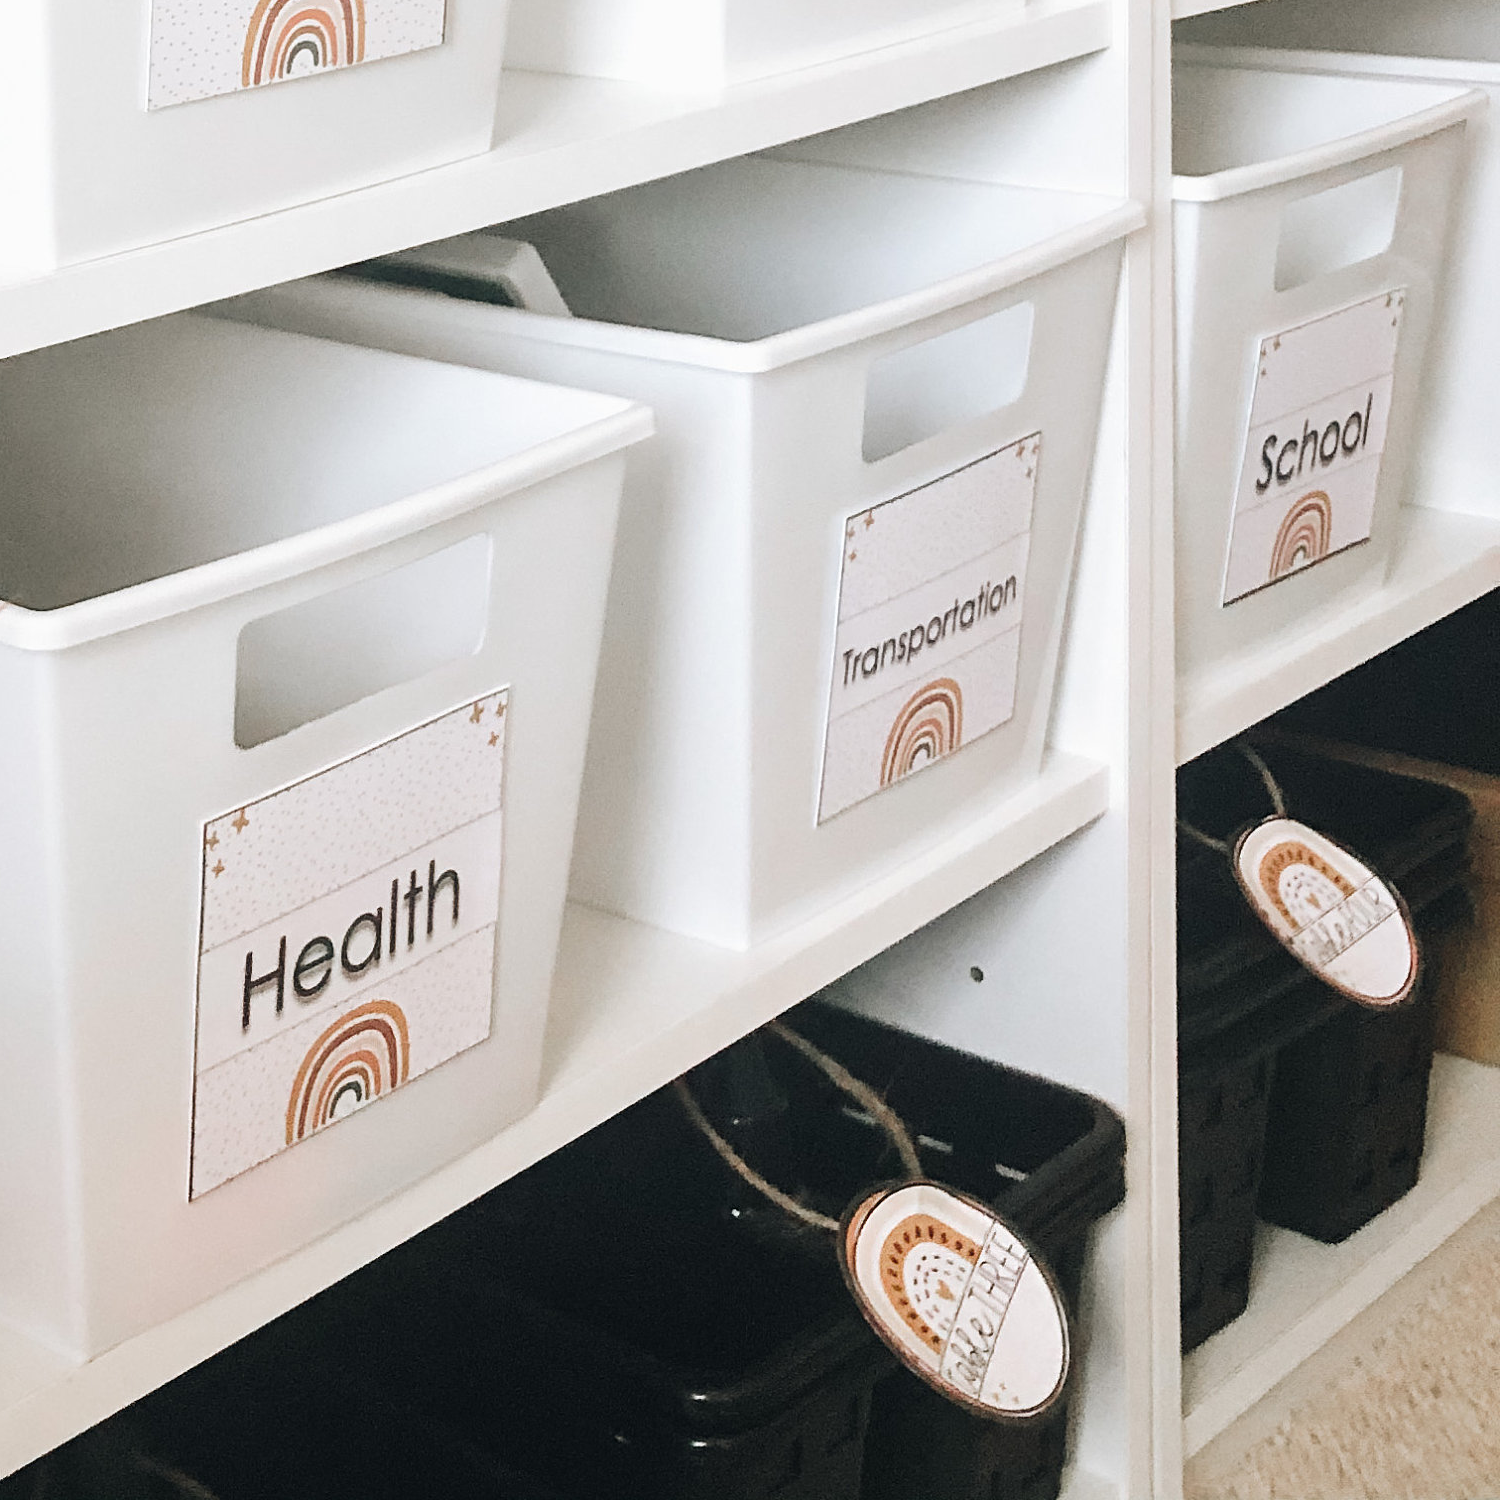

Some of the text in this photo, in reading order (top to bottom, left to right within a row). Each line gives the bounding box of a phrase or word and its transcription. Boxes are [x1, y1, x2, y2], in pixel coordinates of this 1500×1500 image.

[1255, 391, 1373, 491] School
[842, 574, 1017, 686] Transportation
[241, 858, 461, 1030] Health
